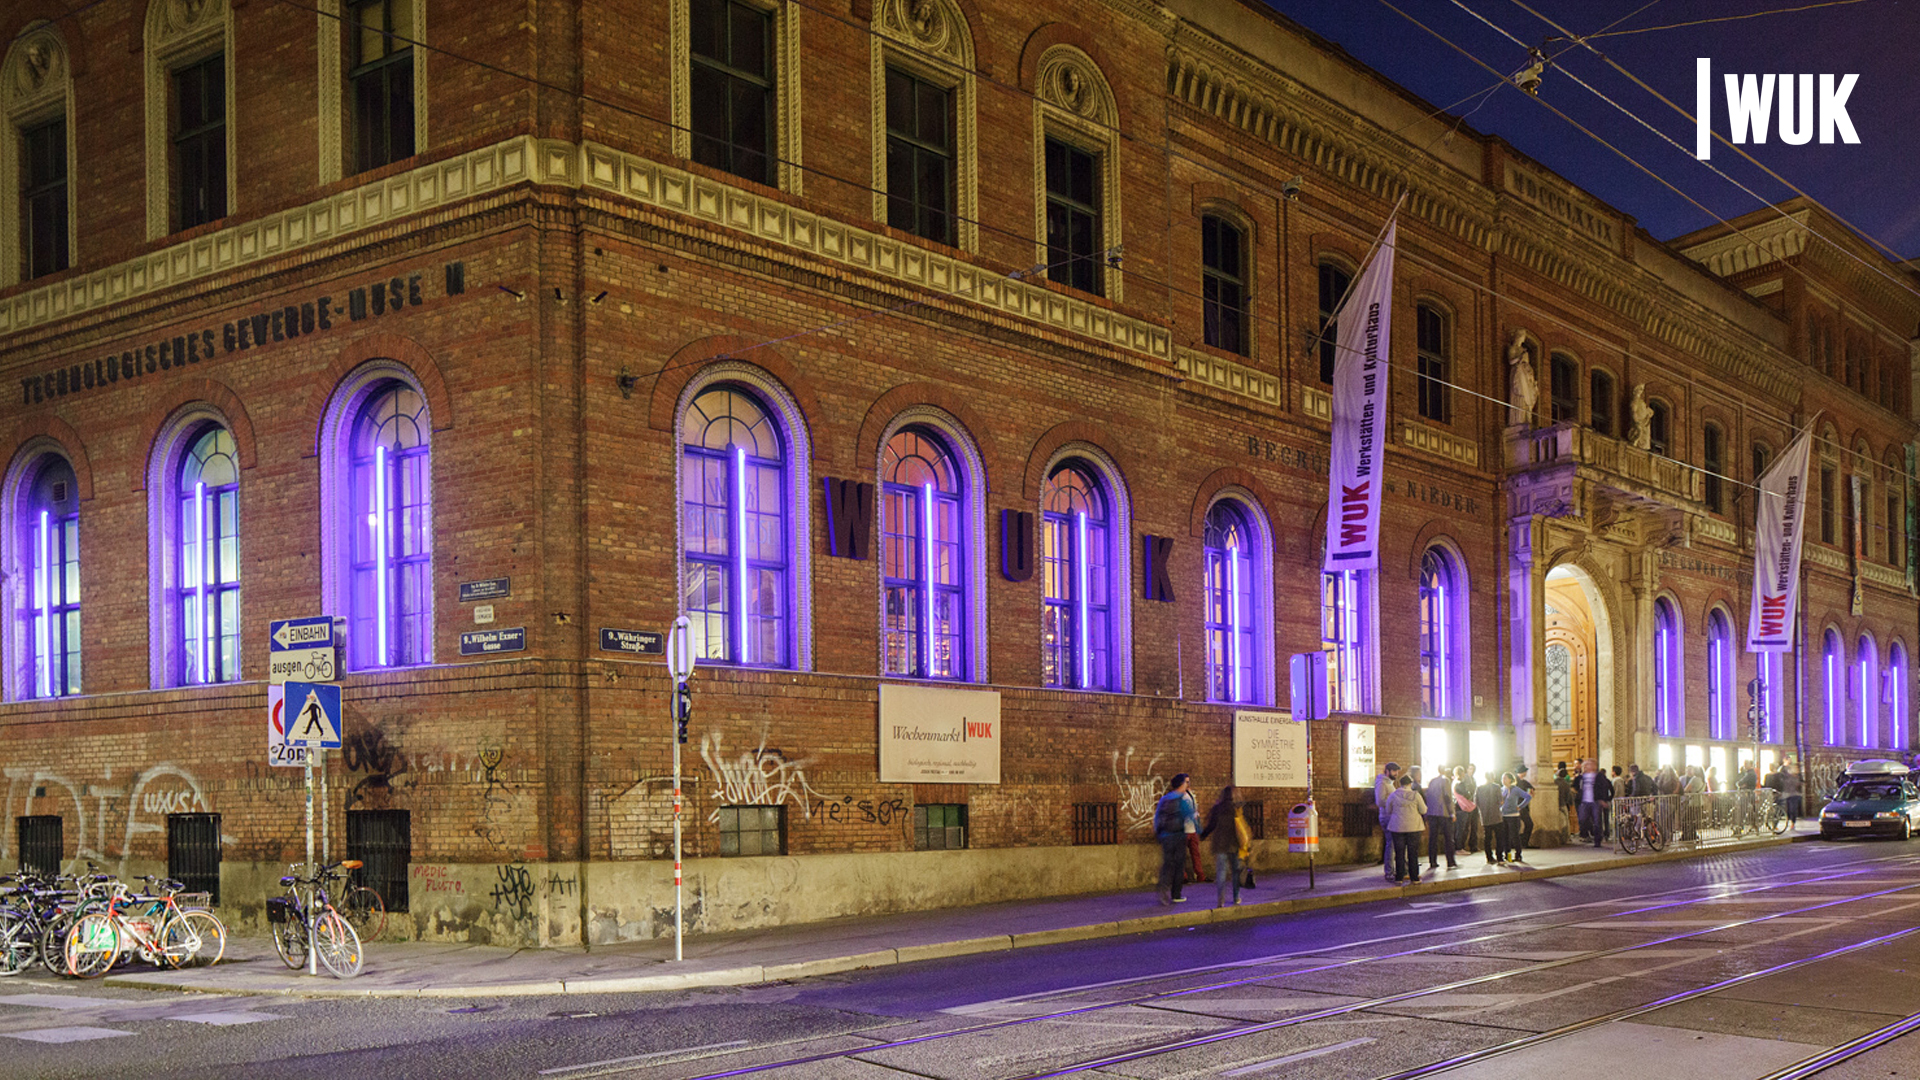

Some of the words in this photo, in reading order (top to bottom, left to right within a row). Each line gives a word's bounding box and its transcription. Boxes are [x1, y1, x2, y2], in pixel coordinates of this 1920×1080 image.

[1363, 302, 1380, 373] Kulturhaus
[20, 328, 216, 405] TECHNOLOGISCHES
[1364, 373, 1376, 396] und
[1356, 399, 1375, 478] Werkstätten-
[1340, 480, 1371, 547] WUK
[1759, 594, 1787, 637] WUK
[289, 625, 327, 642] EINBAHN
[271, 660, 305, 677] ausgen.
[1238, 715, 1269, 724] KUNSTHALLE
[892, 725, 961, 742] Wochenmarkt
[967, 721, 992, 739] WUK
[1267, 728, 1280, 739] DIE
[1250, 738, 1295, 750] SYMMETRIE
[1266, 749, 1281, 760] DES
[1254, 760, 1291, 771] WASSERS
